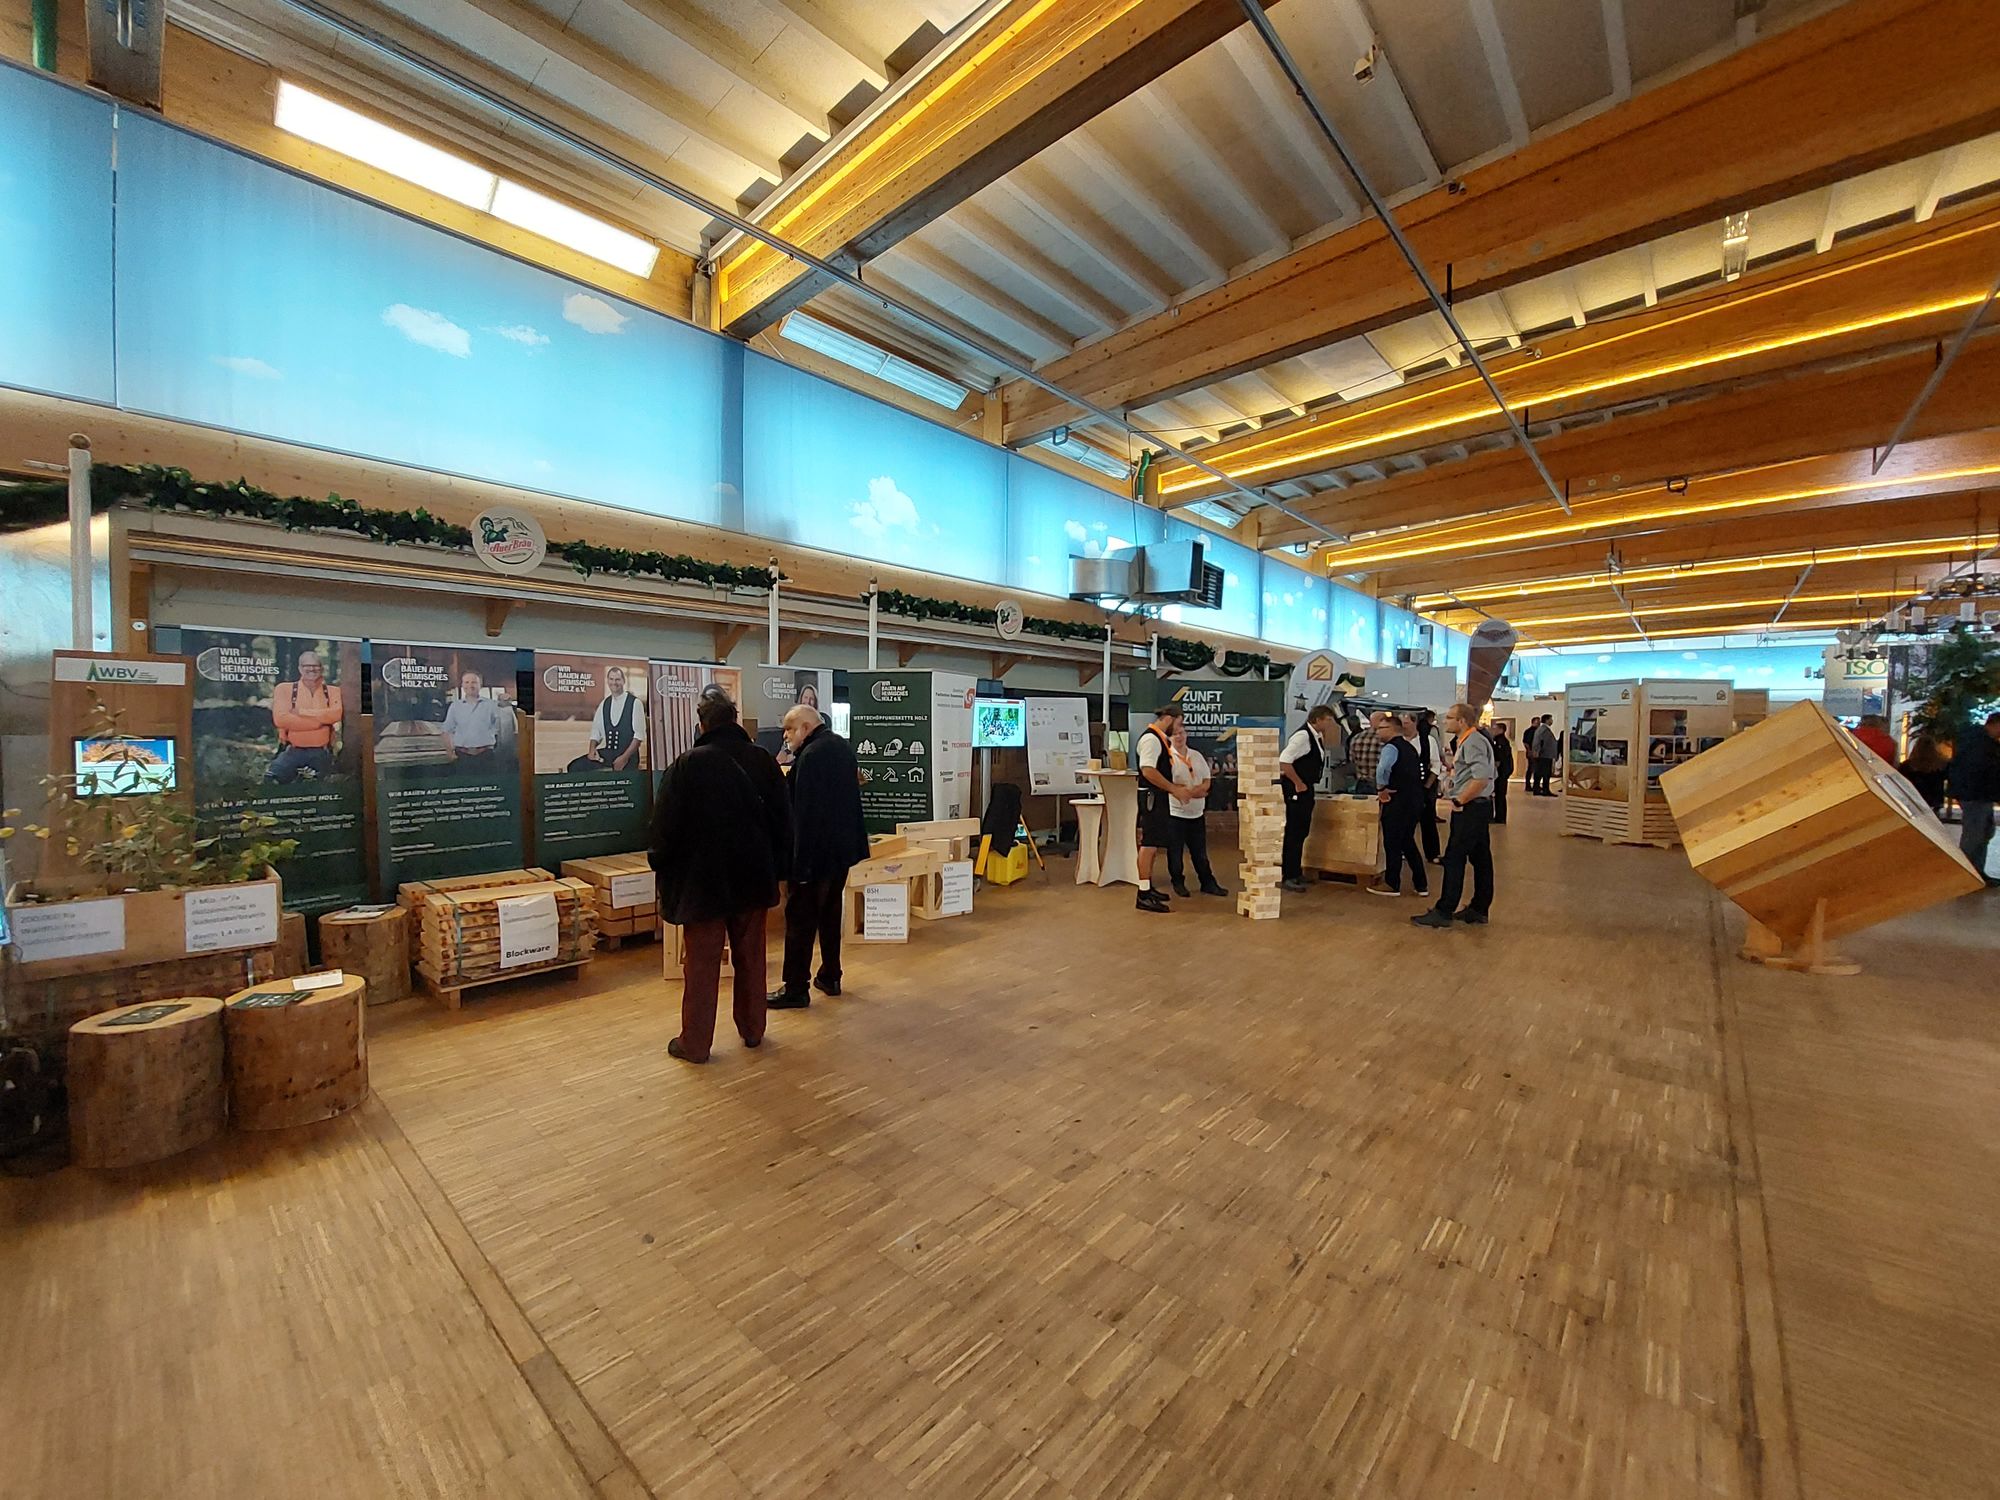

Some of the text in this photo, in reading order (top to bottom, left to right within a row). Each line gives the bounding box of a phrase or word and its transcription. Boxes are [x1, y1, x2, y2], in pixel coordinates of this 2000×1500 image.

[220, 648, 240, 656] WIR
[220, 656, 275, 666] BAUEN AUF
[98, 667, 138, 678] WBV
[221, 665, 280, 675] HEIMISCHES
[221, 673, 265, 683] HOLZ e.V.
[401, 673, 449, 681] HEIMISCHES
[559, 679, 596, 687] HEIMISCHES
[1182, 691, 1223, 702] ZUNFT
[1182, 703, 1222, 712] SCHAFFT
[1182, 713, 1240, 725] ZUKUNFT
[505, 944, 551, 959] Blockware
